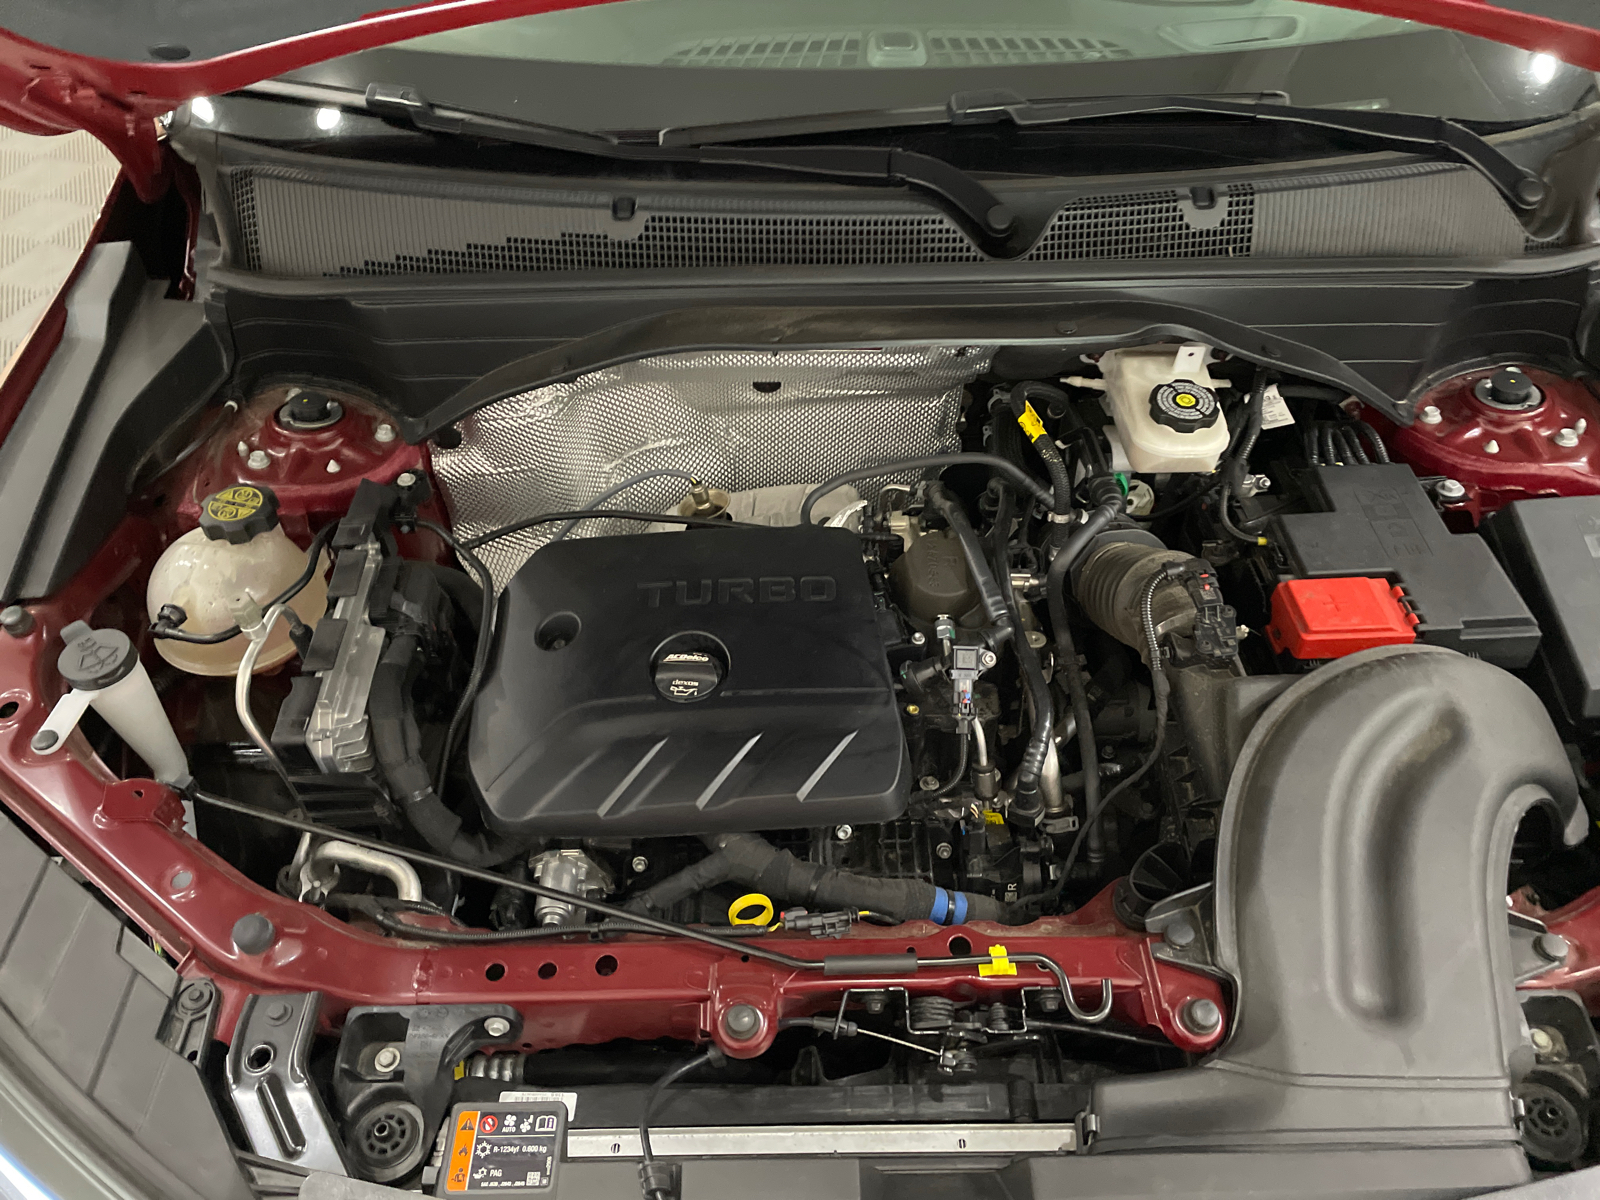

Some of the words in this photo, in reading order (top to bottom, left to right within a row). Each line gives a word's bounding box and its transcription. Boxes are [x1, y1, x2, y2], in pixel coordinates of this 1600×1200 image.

[637, 576, 837, 607] TURBO
[493, 1146, 520, 1154] R-1234yf
[539, 1145, 547, 1154] kg
[489, 1169, 502, 1177] PAG
